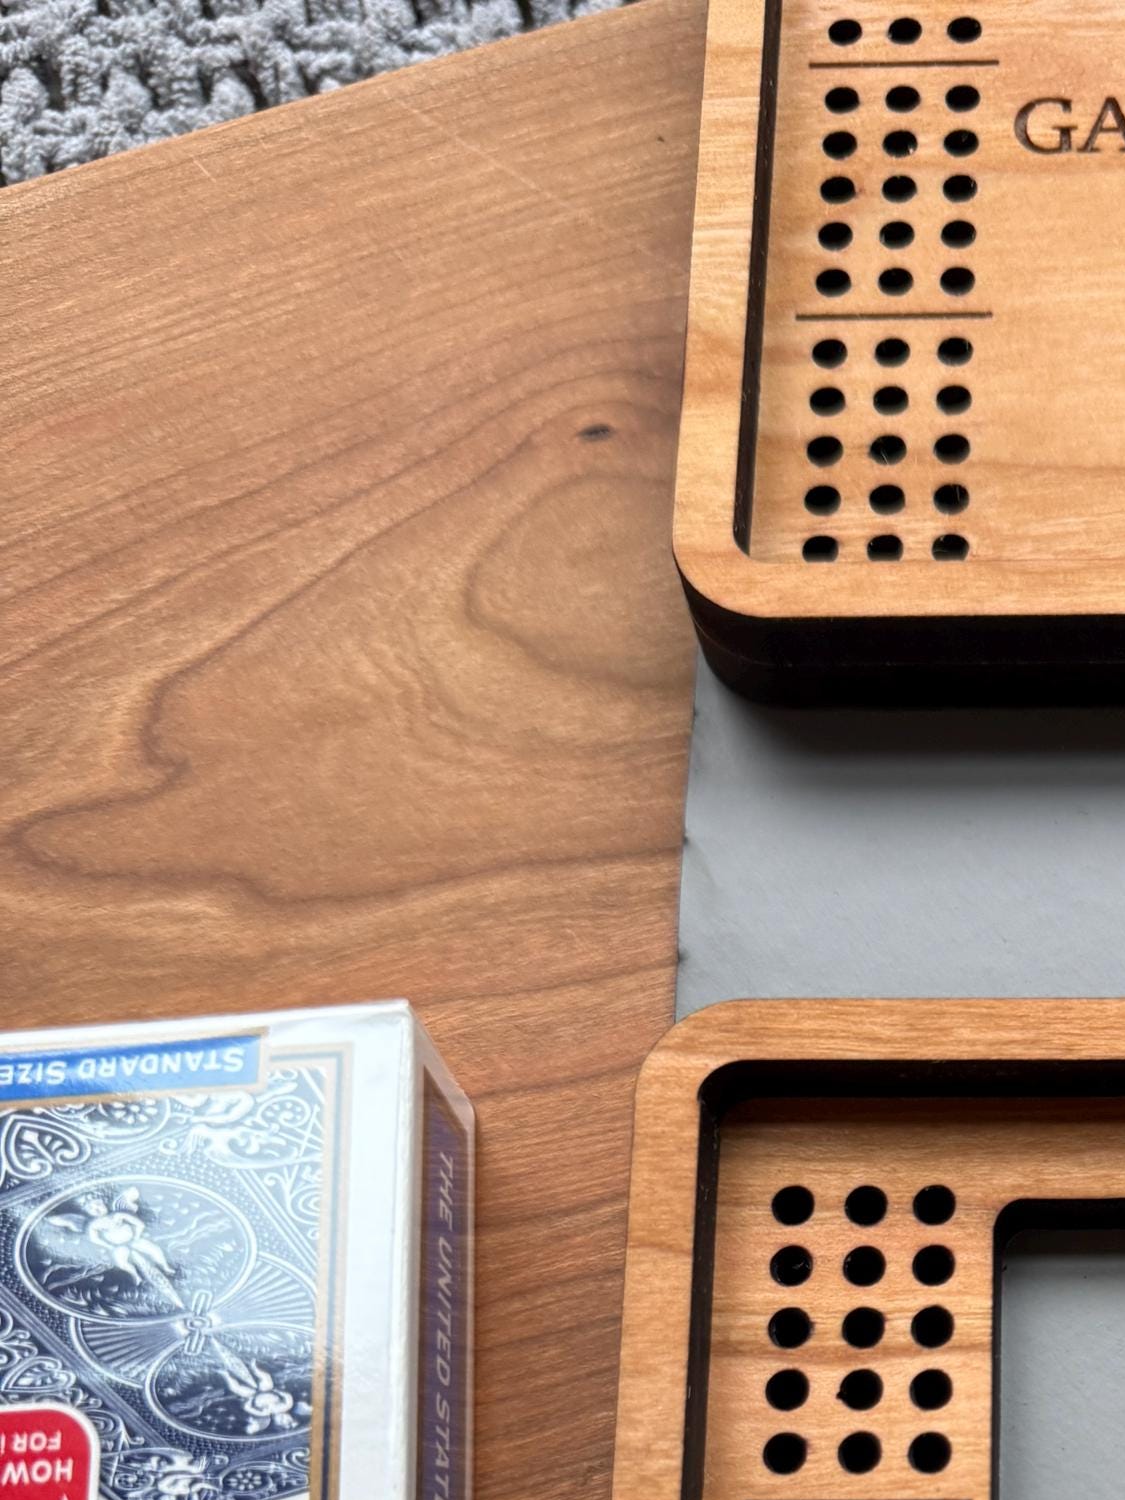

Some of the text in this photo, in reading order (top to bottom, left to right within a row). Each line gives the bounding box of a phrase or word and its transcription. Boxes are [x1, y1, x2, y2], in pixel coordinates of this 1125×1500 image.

[0, 1047, 245, 1086] STANDARD SIZE
[438, 1151, 454, 1232] THE
[436, 1236, 453, 1388] UNITED
[12, 1430, 62, 1454] FOR
[1, 1457, 74, 1487] HOW
